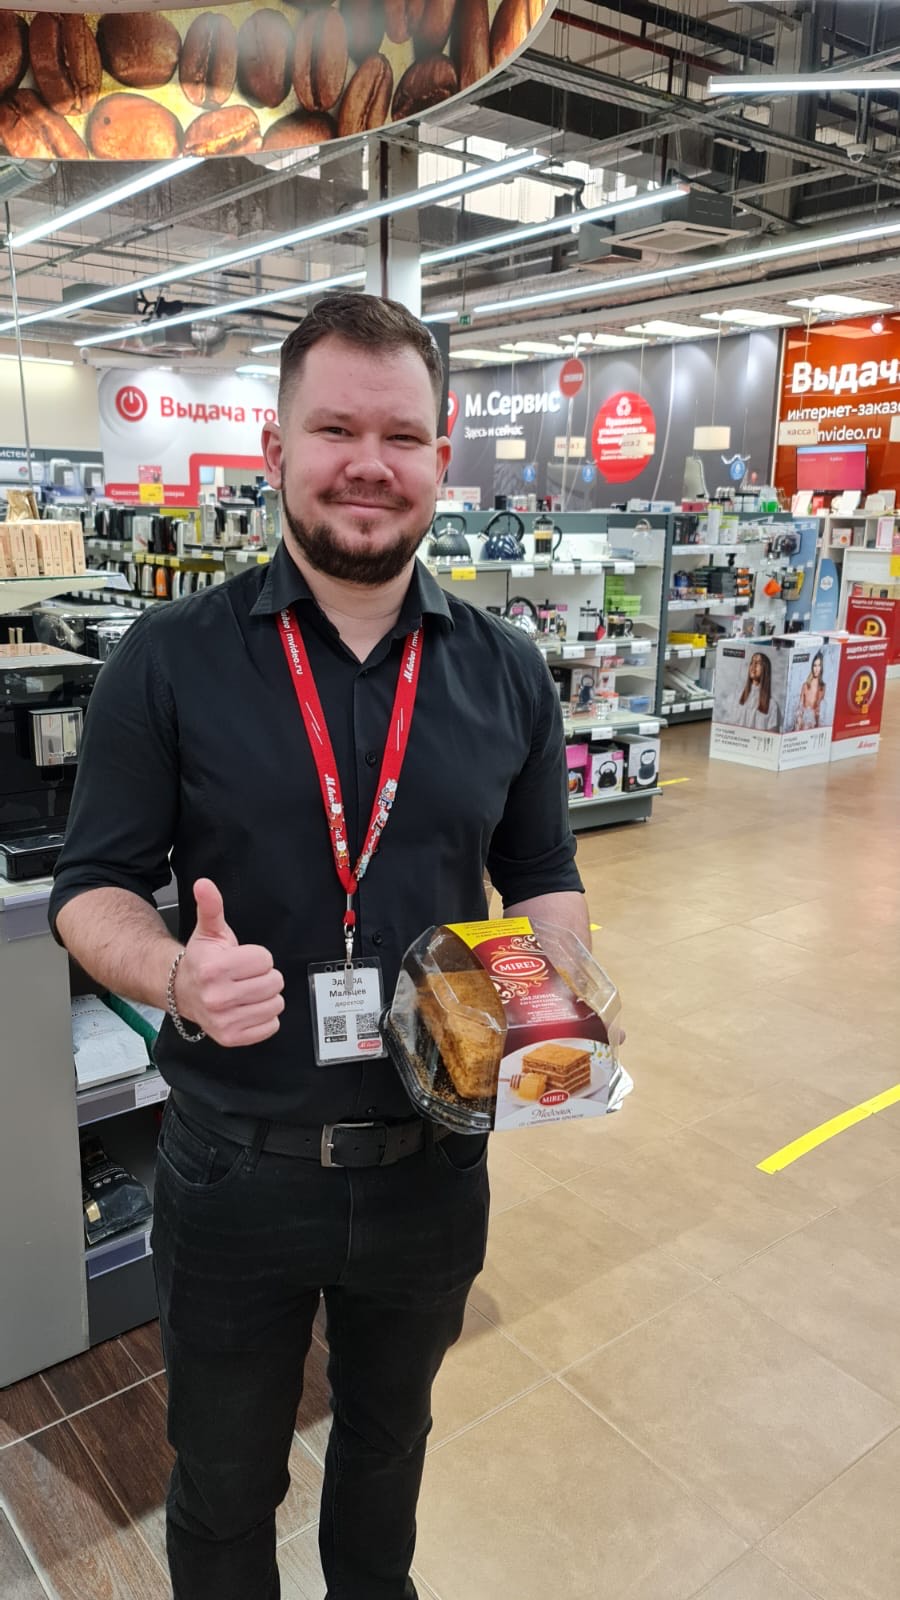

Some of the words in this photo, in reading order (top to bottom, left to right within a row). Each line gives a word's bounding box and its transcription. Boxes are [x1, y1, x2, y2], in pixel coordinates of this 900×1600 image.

[791, 359, 900, 395] Выдач
[160, 396, 246, 424] Выдача
[464, 391, 561, 423] М.Сервис
[464, 426, 488, 439] Здесь
[488, 427, 494, 437] и
[494, 425, 524, 437] сейчас
[286, 633, 304, 675] mvideo.ru
[499, 960, 539, 972] MIREL
[329, 988, 367, 998] Мальцев
[335, 1000, 365, 1008] директор
[541, 1094, 566, 1104] MIREL
[531, 1107, 572, 1119] Медовик
